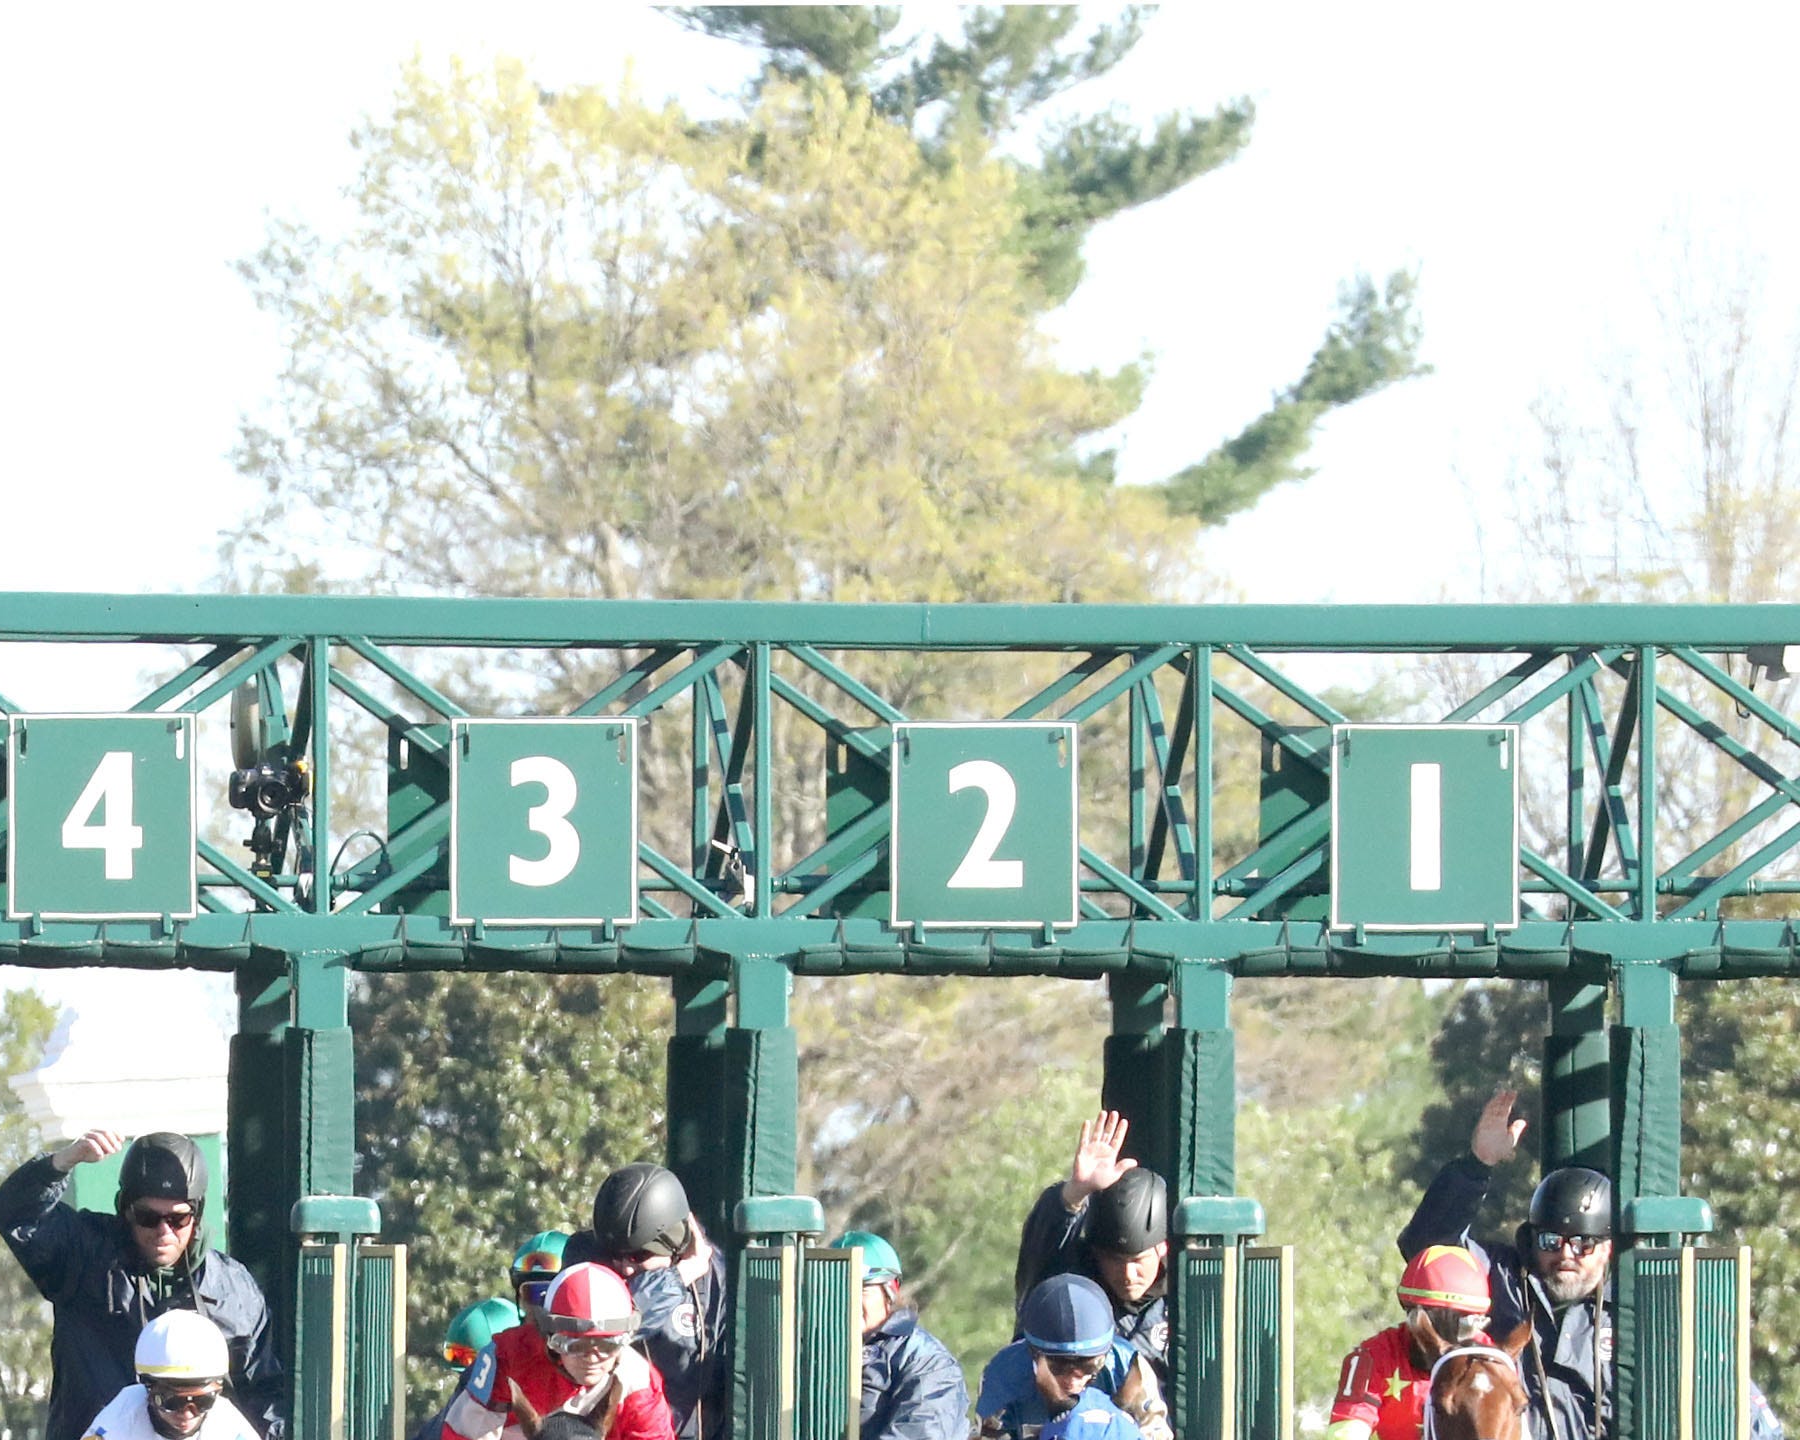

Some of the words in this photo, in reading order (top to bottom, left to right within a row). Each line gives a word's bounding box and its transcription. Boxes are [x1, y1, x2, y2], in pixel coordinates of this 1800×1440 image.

[61, 751, 143, 880] 4
[509, 756, 580, 887] 3
[946, 760, 1024, 889] 2
[1410, 763, 1441, 891] 1
[473, 1353, 492, 1389] 3
[1342, 1355, 1360, 1396] 1
